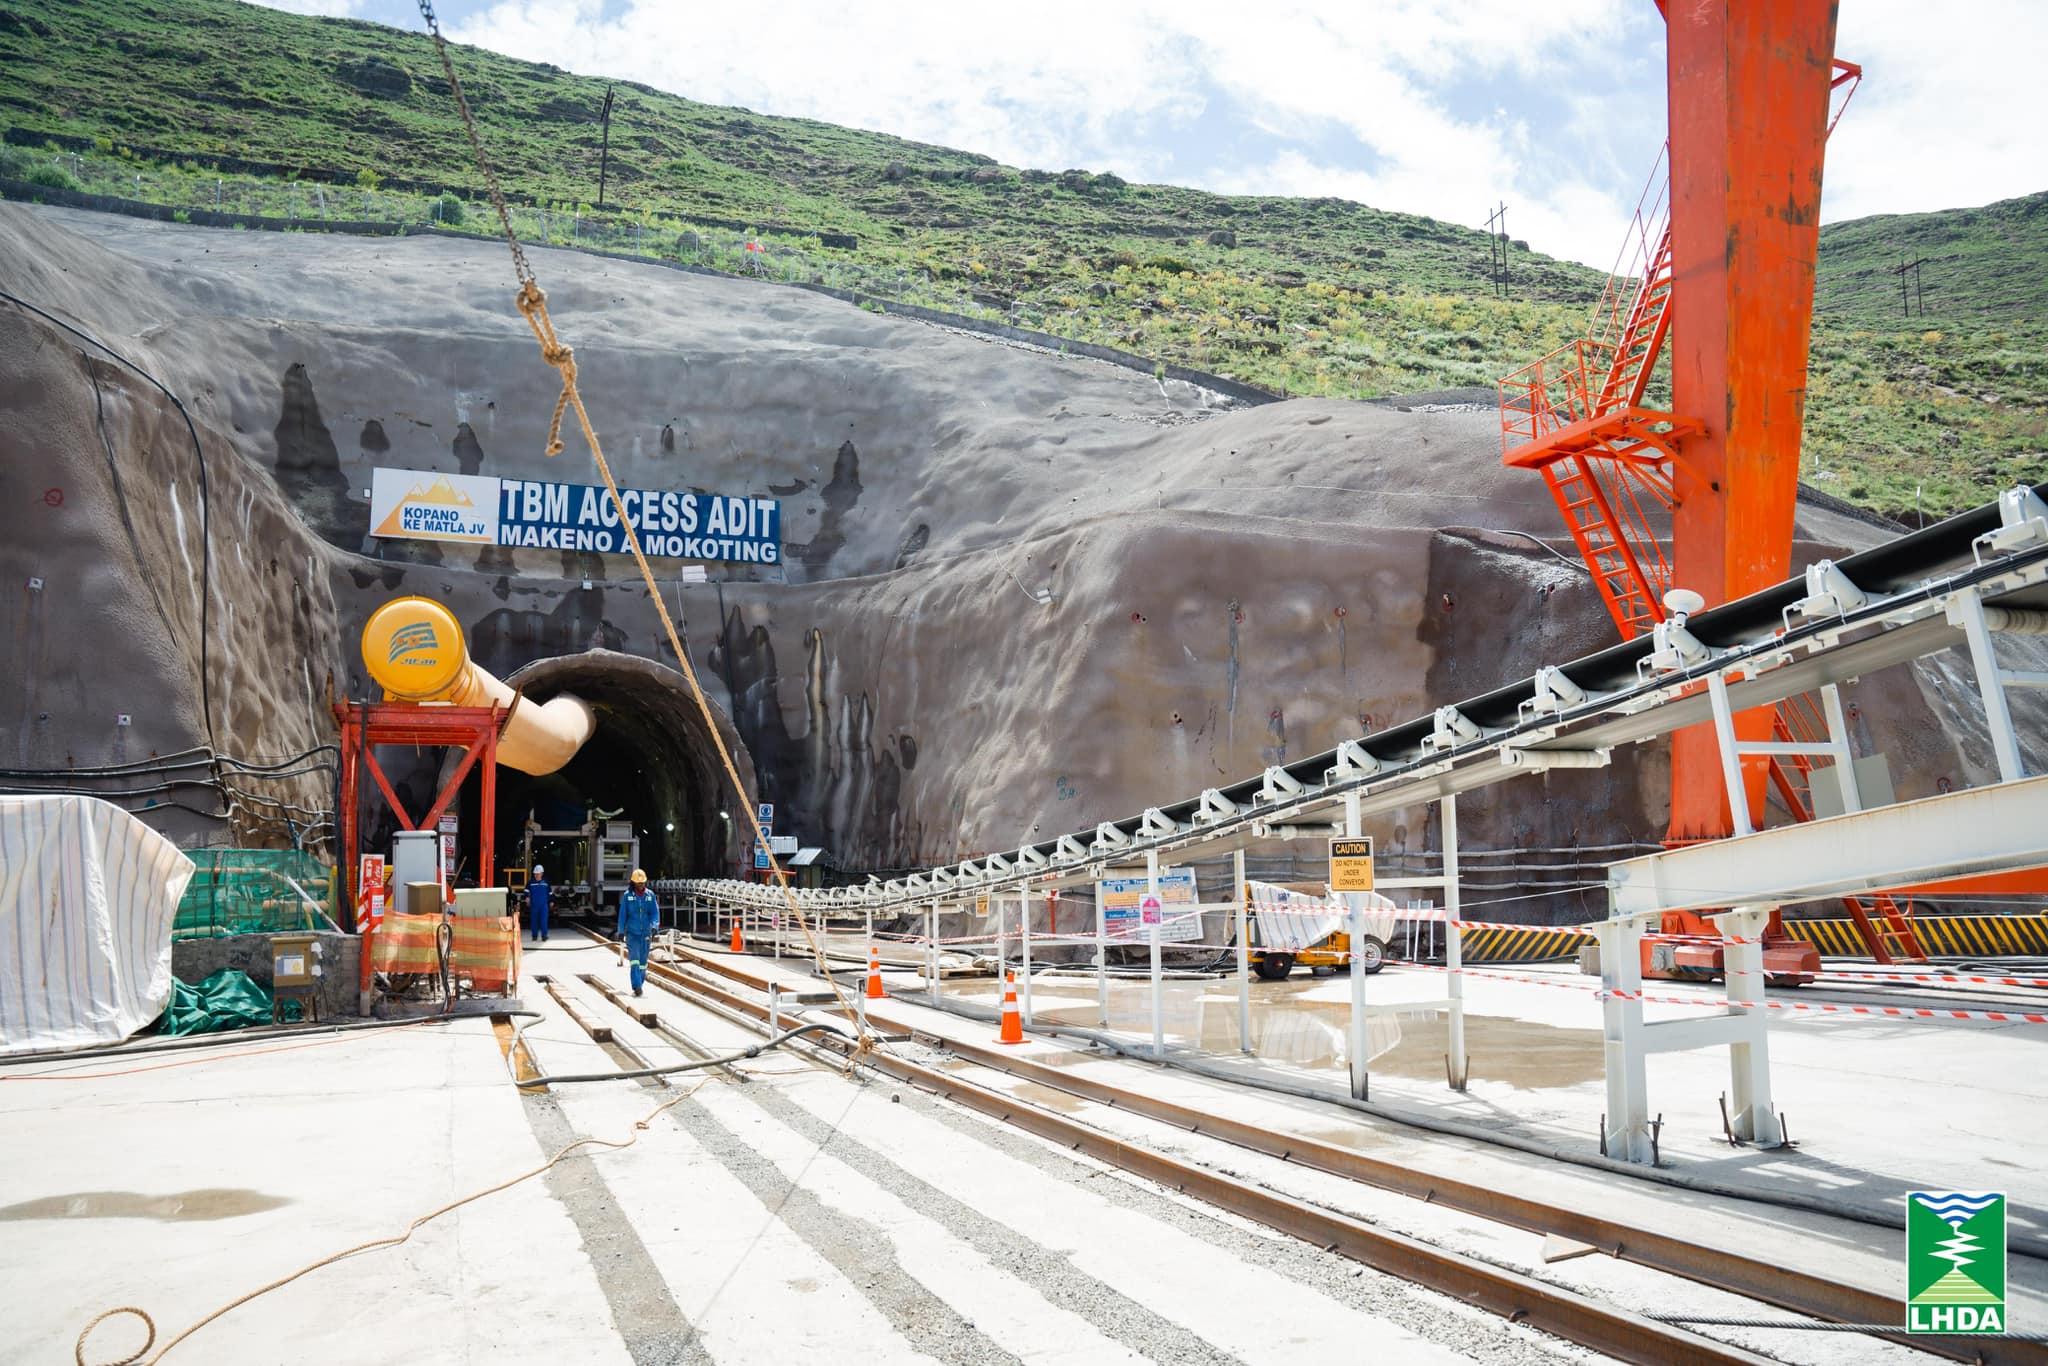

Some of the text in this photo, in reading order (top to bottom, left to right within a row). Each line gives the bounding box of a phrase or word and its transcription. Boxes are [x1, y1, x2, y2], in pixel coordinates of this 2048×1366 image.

[404, 507, 459, 521] KOPANO
[502, 480, 776, 538] TBM ACCESS ADIT
[403, 519, 485, 535] KE MATLA JV
[501, 524, 613, 552] MAKENO
[646, 534, 777, 563] MOKOTING
[1335, 843, 1367, 855] CAUTION
[1335, 859, 1342, 867] DO
[1343, 859, 1353, 867] NOT
